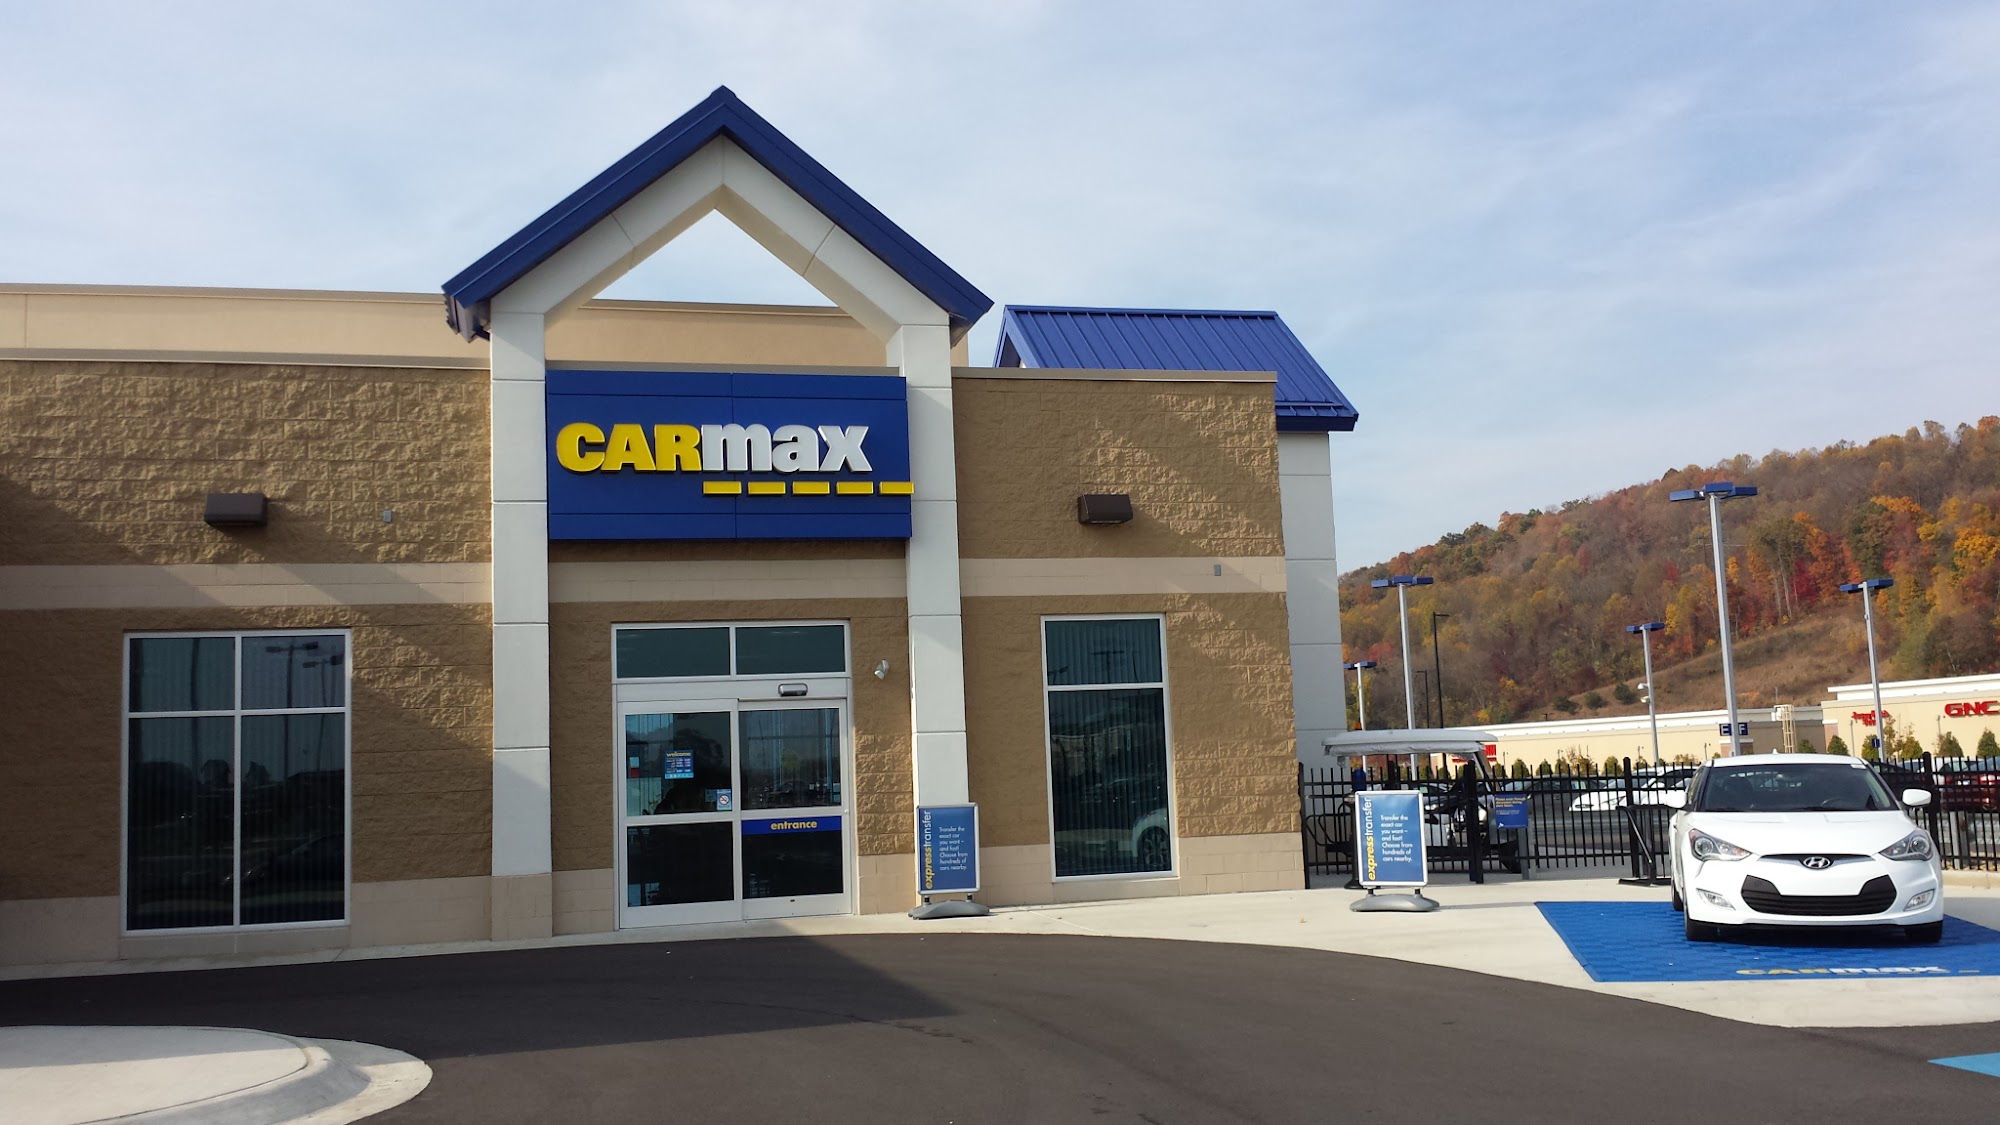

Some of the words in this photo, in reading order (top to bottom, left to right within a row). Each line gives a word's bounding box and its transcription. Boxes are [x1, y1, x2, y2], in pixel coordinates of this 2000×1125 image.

[556, 422, 873, 473] CARmax
[1944, 701, 2000, 717] GNC
[1739, 723, 1746, 735] F
[770, 821, 818, 830] entrance
